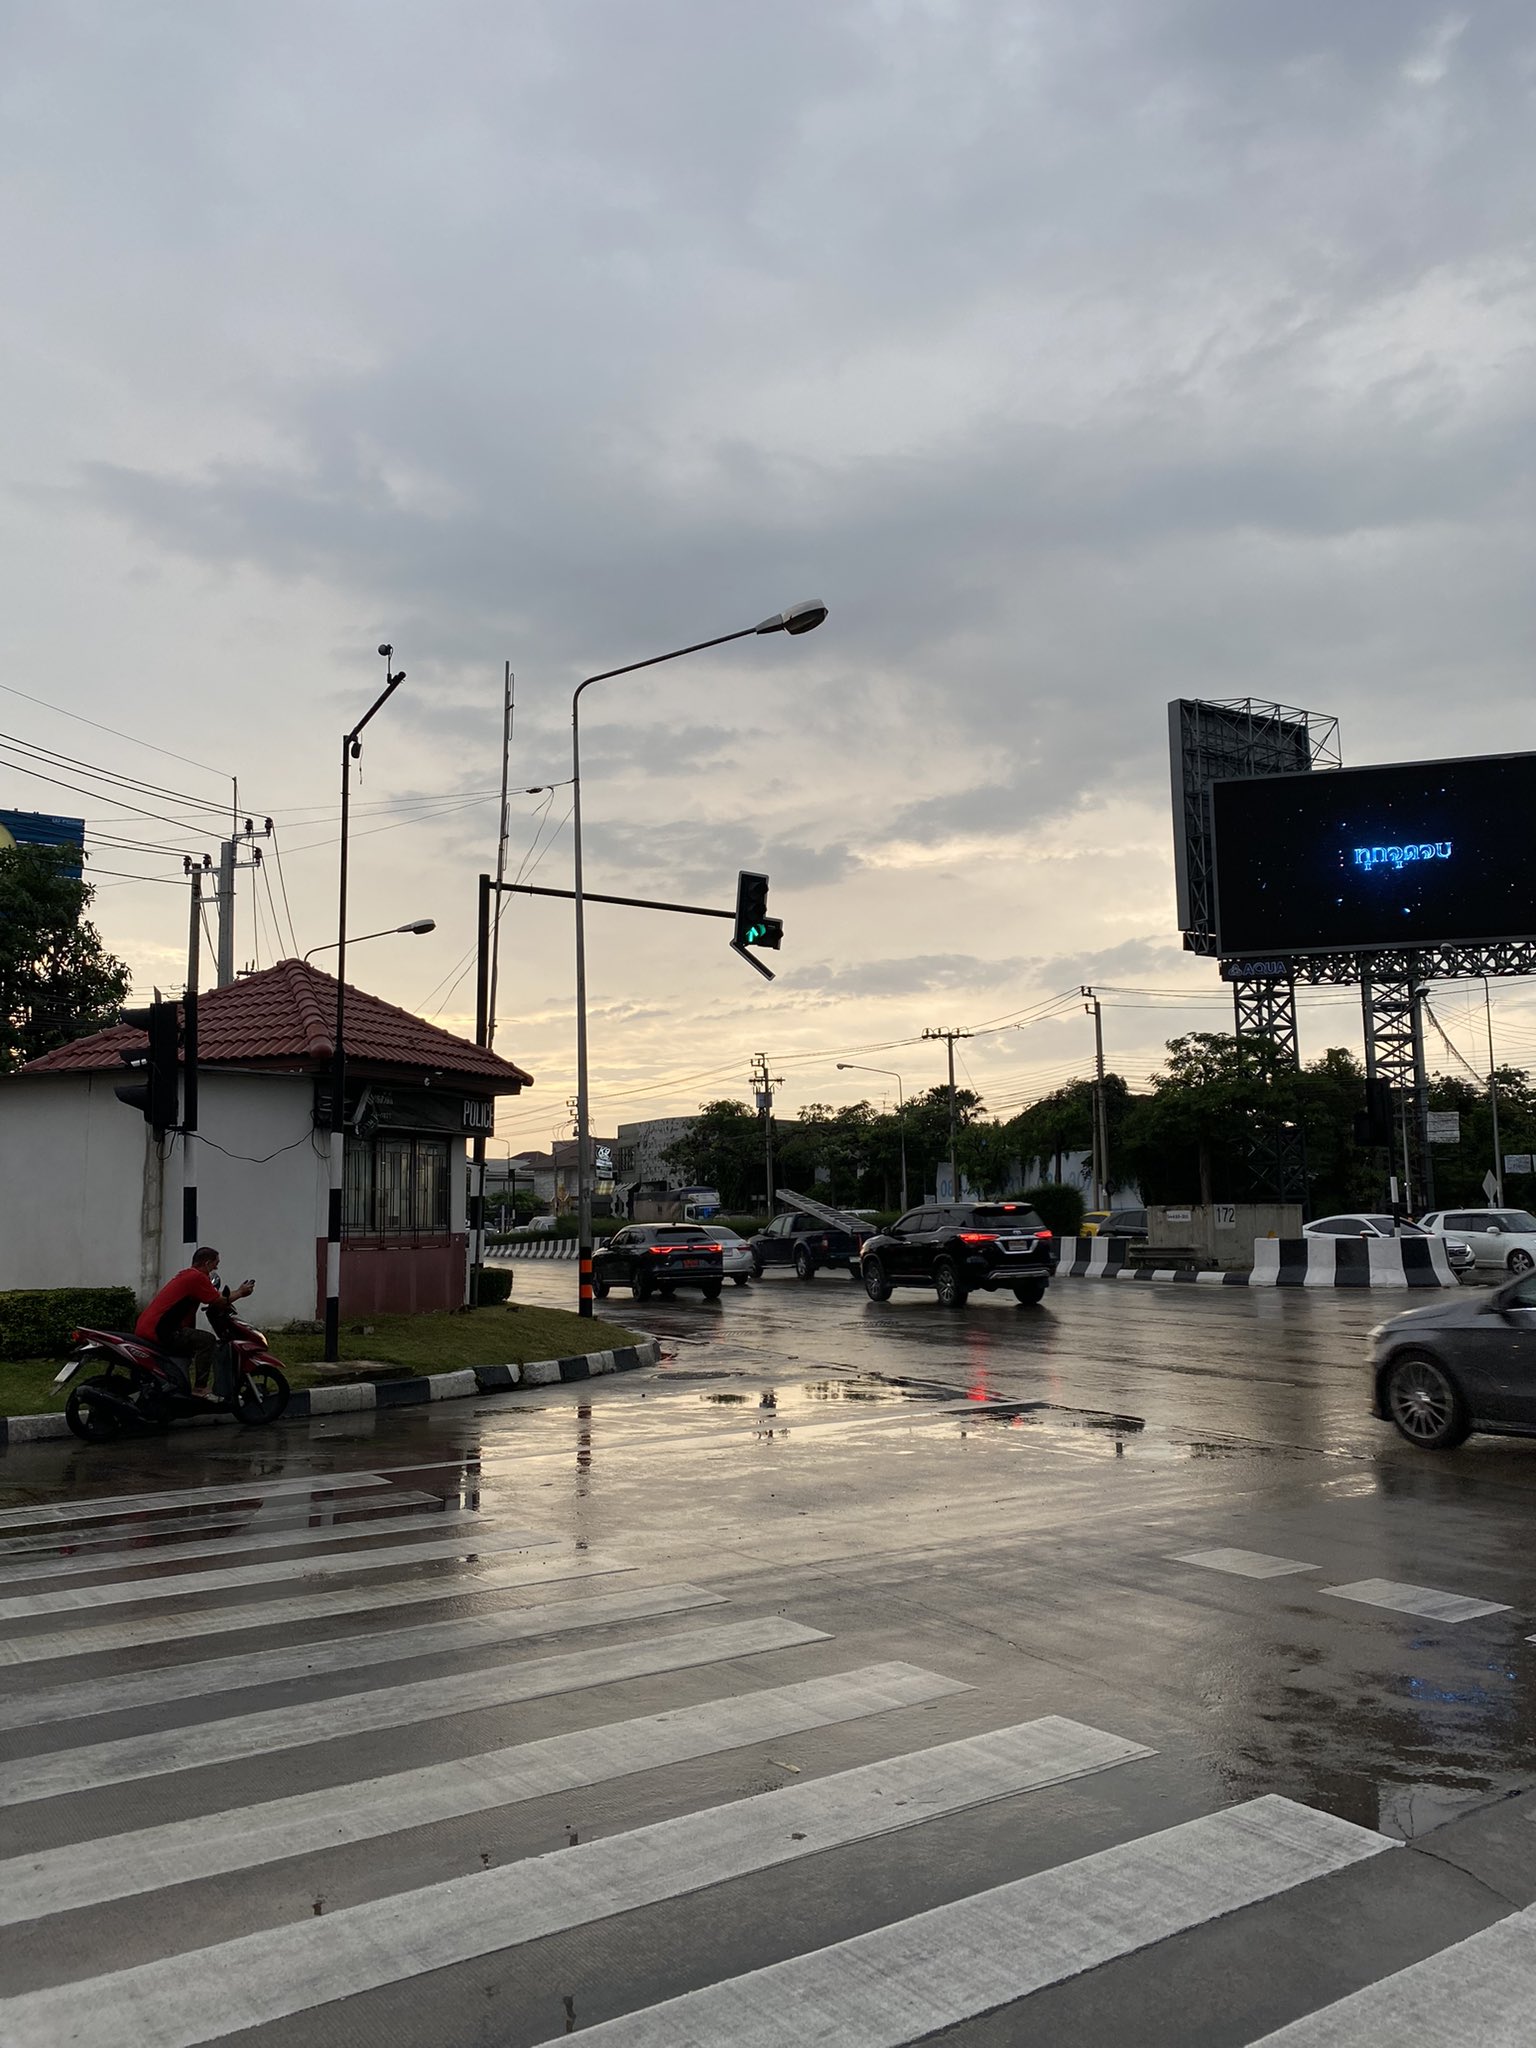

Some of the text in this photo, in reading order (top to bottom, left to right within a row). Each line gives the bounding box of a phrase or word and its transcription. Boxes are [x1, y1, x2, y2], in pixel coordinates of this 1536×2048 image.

[1243, 961, 1287, 976] AQUA
[463, 1100, 494, 1129] POLICE
[1217, 1207, 1235, 1223] 172
